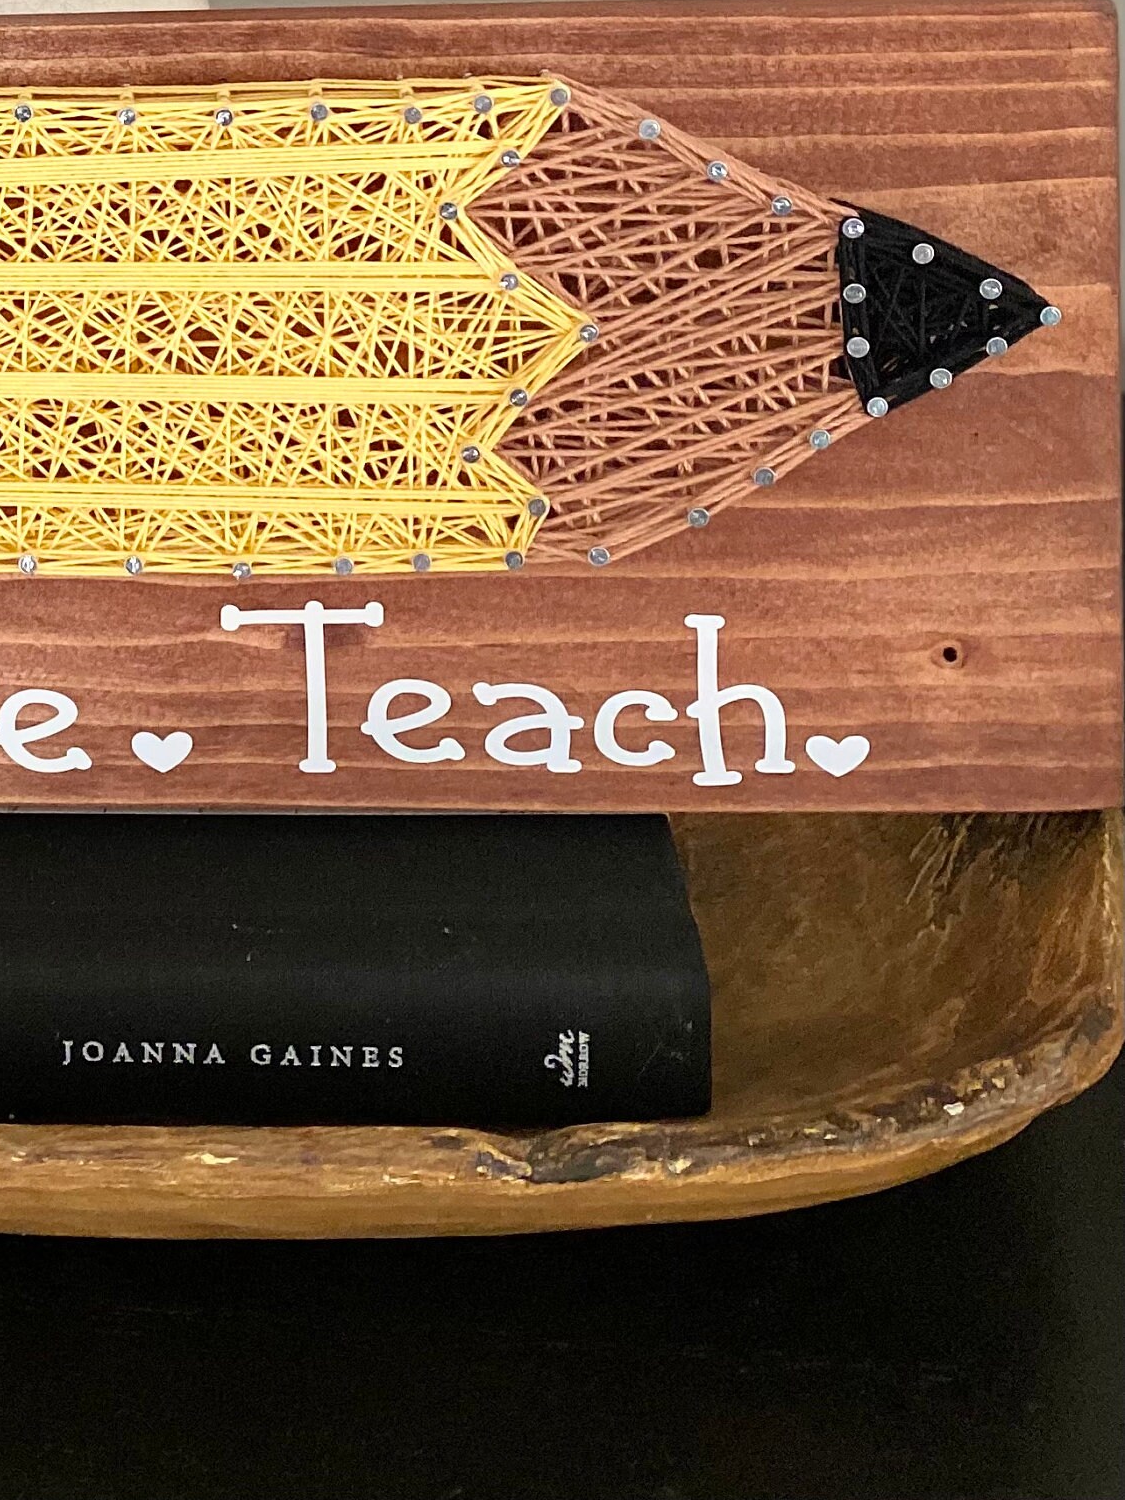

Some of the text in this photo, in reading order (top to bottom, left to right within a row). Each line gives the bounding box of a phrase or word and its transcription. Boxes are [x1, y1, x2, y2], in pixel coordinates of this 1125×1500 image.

[220, 600, 796, 786] Teach
[62, 1040, 404, 1068] JOANNA GAINES
